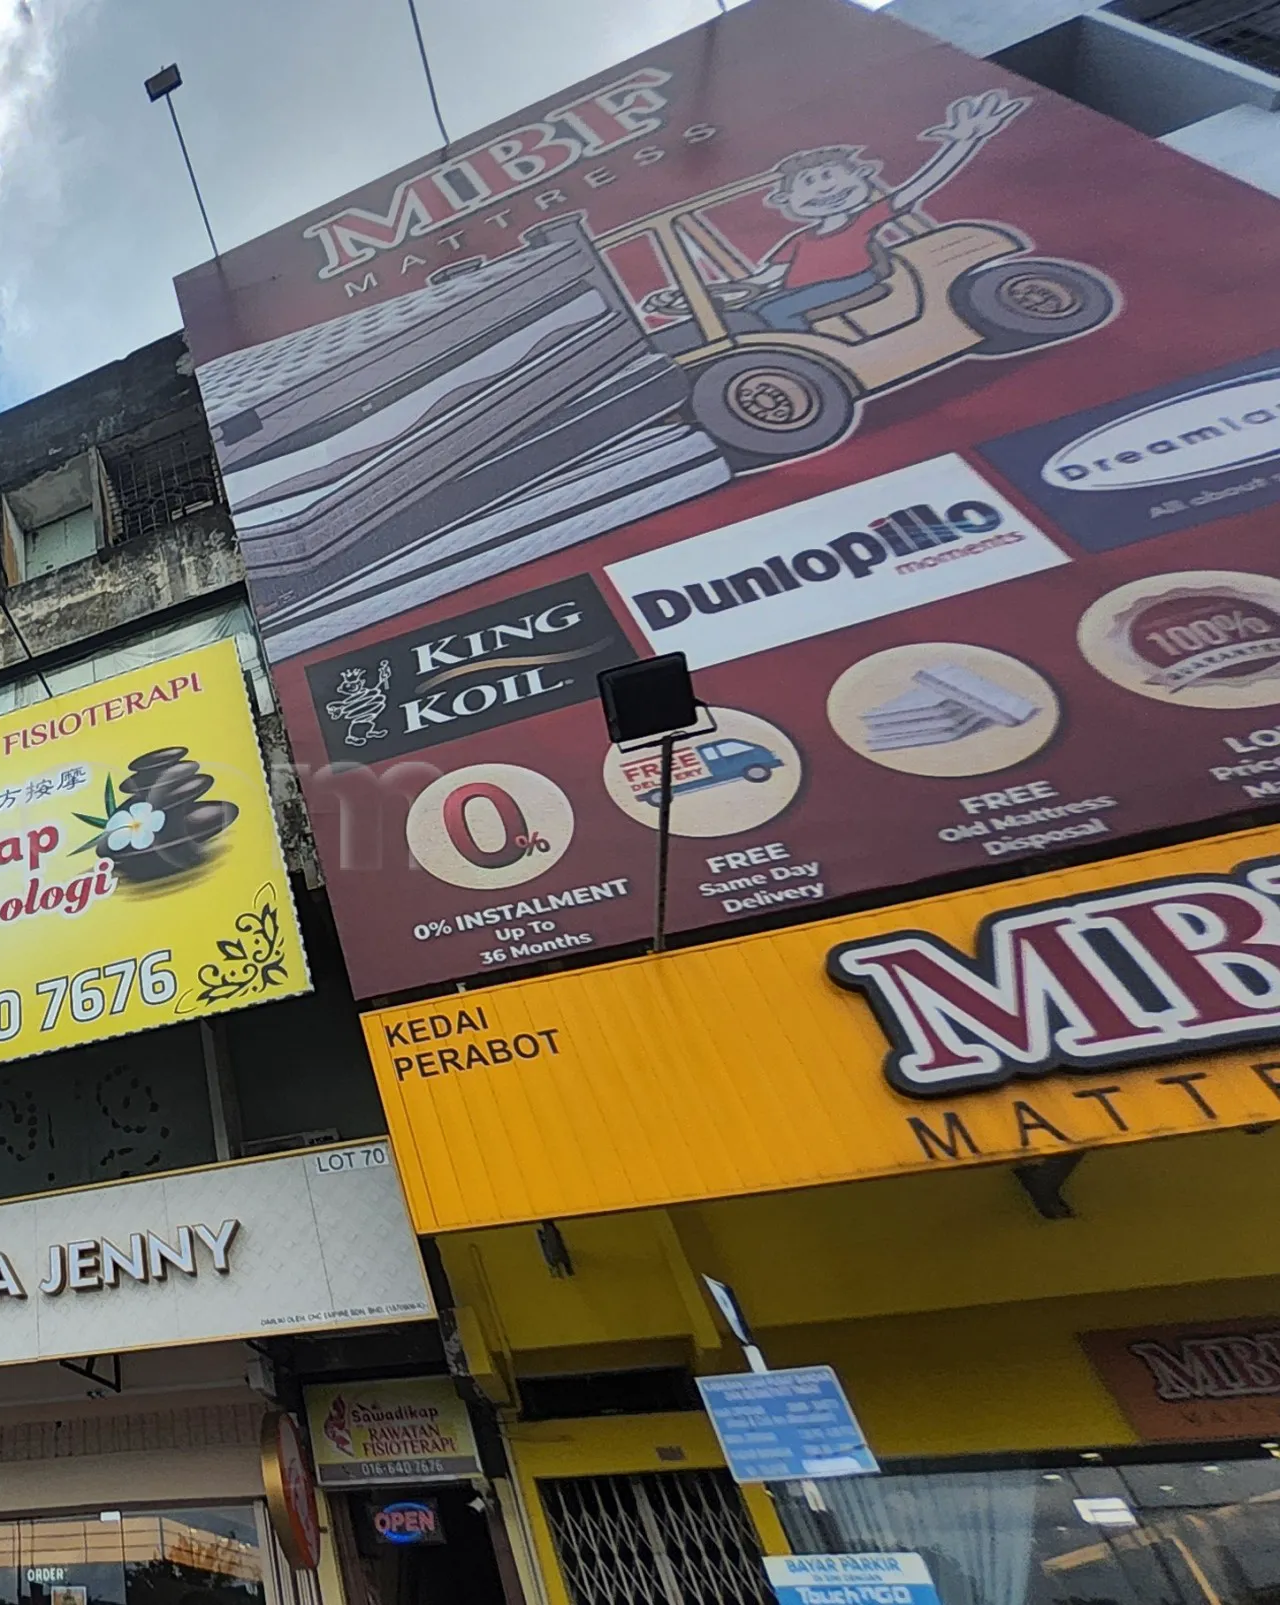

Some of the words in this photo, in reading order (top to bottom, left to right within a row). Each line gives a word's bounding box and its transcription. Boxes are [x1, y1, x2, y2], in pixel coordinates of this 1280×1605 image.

[303, 67, 674, 281] MBF
[344, 122, 716, 299] MATTRESS
[632, 499, 1004, 634] Dunlopillo
[895, 530, 1027, 576] moments
[412, 602, 584, 677] KING
[1145, 610, 1272, 656] 100%
[3, 671, 203, 757] FISIOTERAPI
[399, 666, 565, 734] KOIL
[1222, 725, 1280, 753] LO
[937, 820, 991, 843] Old
[992, 794, 1119, 832] Mattress
[959, 780, 1060, 815] FREE
[706, 842, 791, 875] FREE
[981, 818, 1111, 857] Disposal
[698, 869, 770, 898] Same
[771, 861, 820, 890] Day
[721, 881, 825, 915] Delivery
[413, 917, 452, 942] 0%
[455, 879, 631, 932] INSTALMENT
[495, 924, 524, 943] Up
[526, 917, 556, 936] To
[480, 948, 507, 966] 36
[509, 930, 593, 960] Months
[37, 950, 178, 1031] 7676
[828, 858, 1280, 1098] MB
[384, 1006, 489, 1048] KEDAI
[394, 1029, 561, 1082] PERABOT
[37, 1218, 241, 1298] JENNY
[317, 1152, 356, 1173] LOT
[361, 1147, 387, 1167] 70
[351, 1404, 439, 1423] Sawadikap
[368, 1424, 441, 1442] RAWATAN
[362, 1436, 457, 1457] FISIOTERAPI
[375, 1509, 435, 1534] OPEN
[27, 1567, 64, 1582] ORDER
[785, 1558, 838, 1573] BAYAR
[838, 1556, 902, 1572] PARKIR
